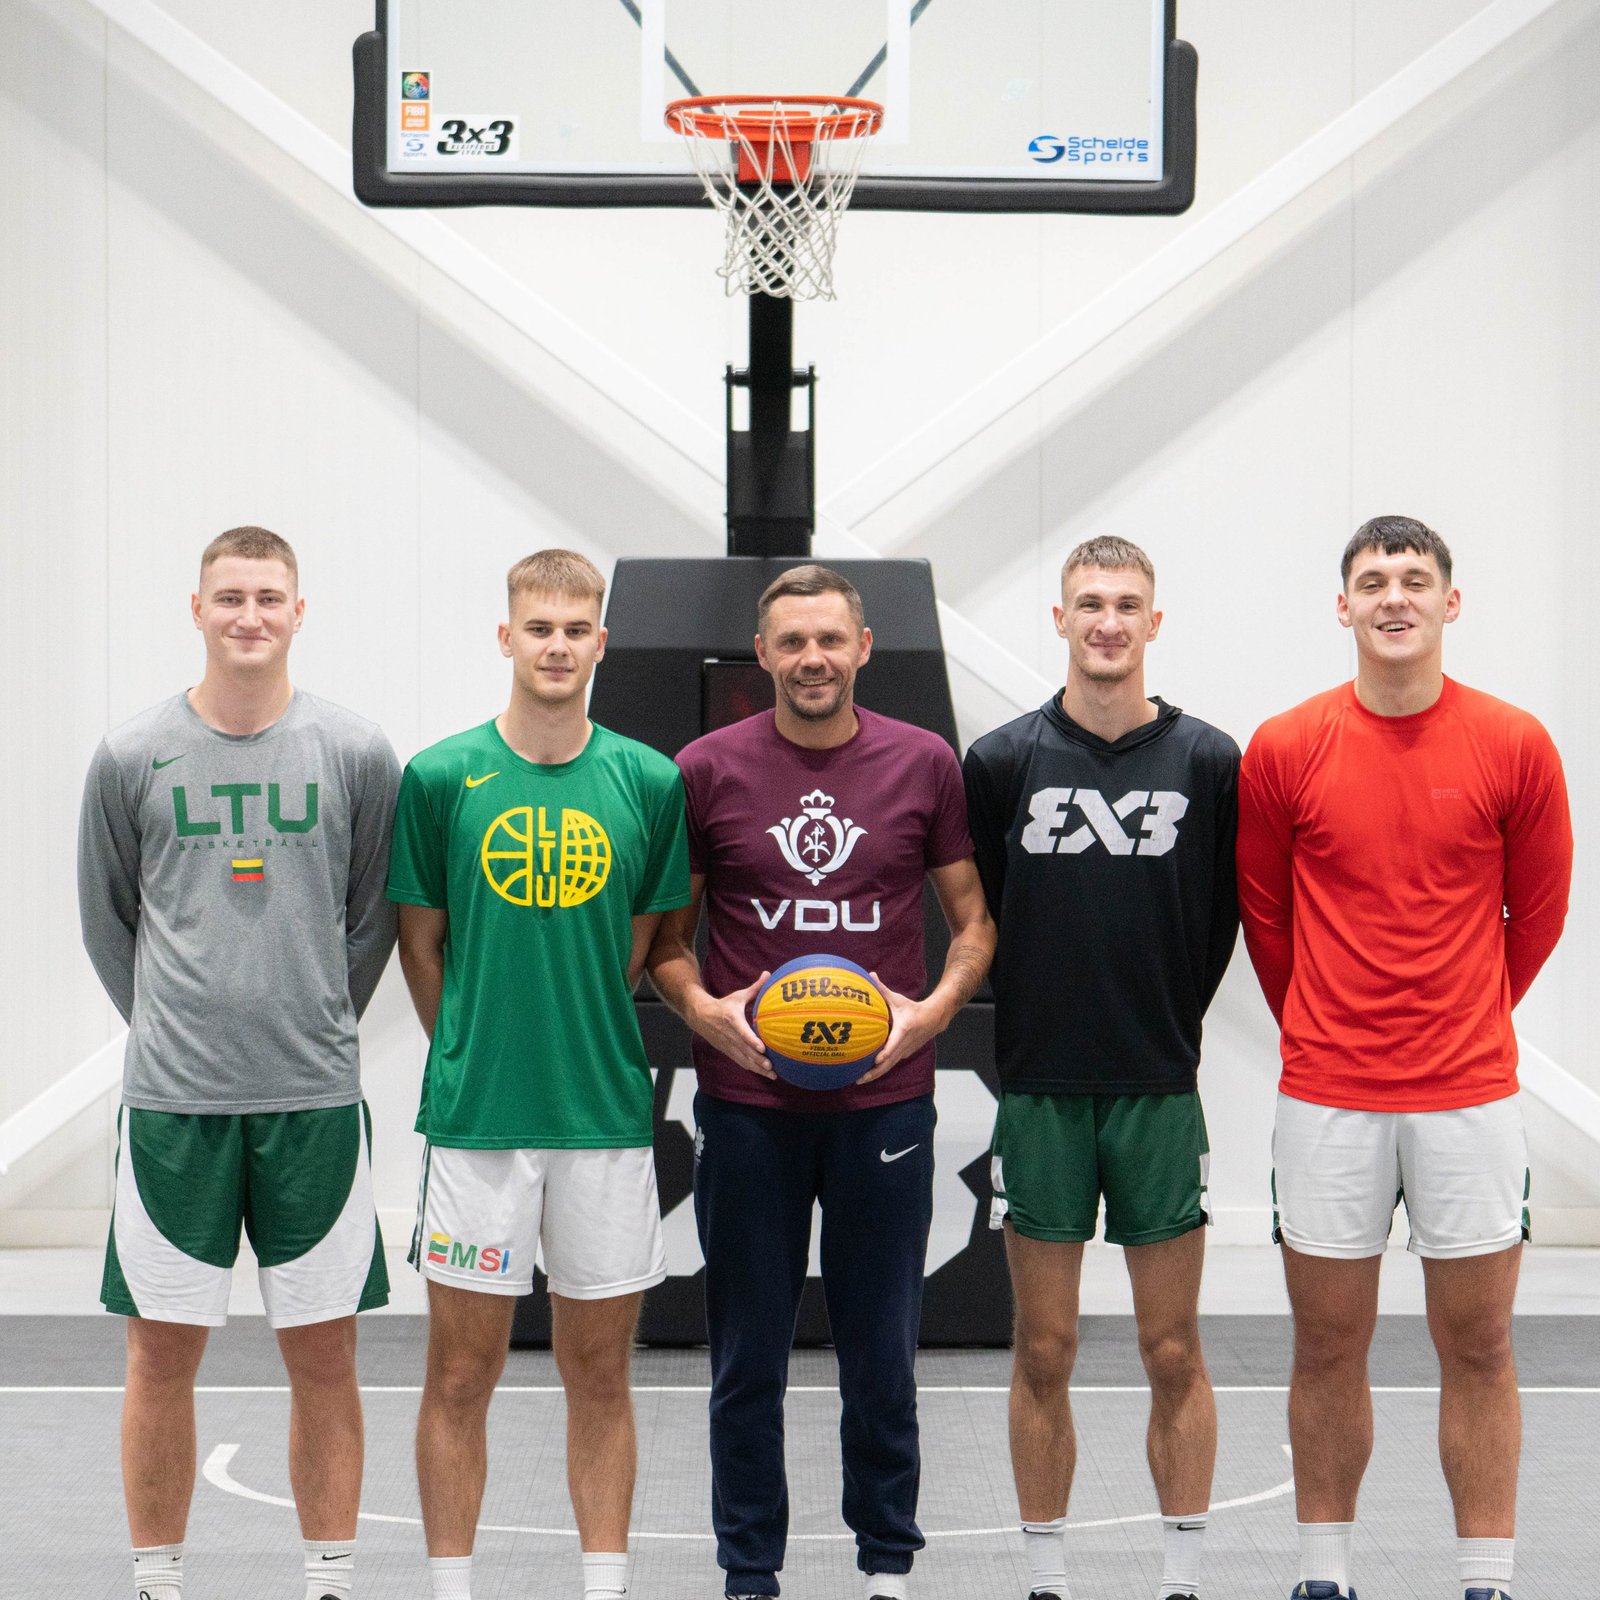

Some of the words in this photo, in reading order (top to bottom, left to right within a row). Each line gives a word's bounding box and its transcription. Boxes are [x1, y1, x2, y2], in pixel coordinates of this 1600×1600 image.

[1068, 136, 1149, 149] Schelde
[1068, 150, 1149, 165] Sports
[172, 783, 319, 837] LTU
[178, 839, 319, 851] BASKETBALL
[751, 899, 880, 931] VDU
[780, 977, 872, 1006] Wilson
